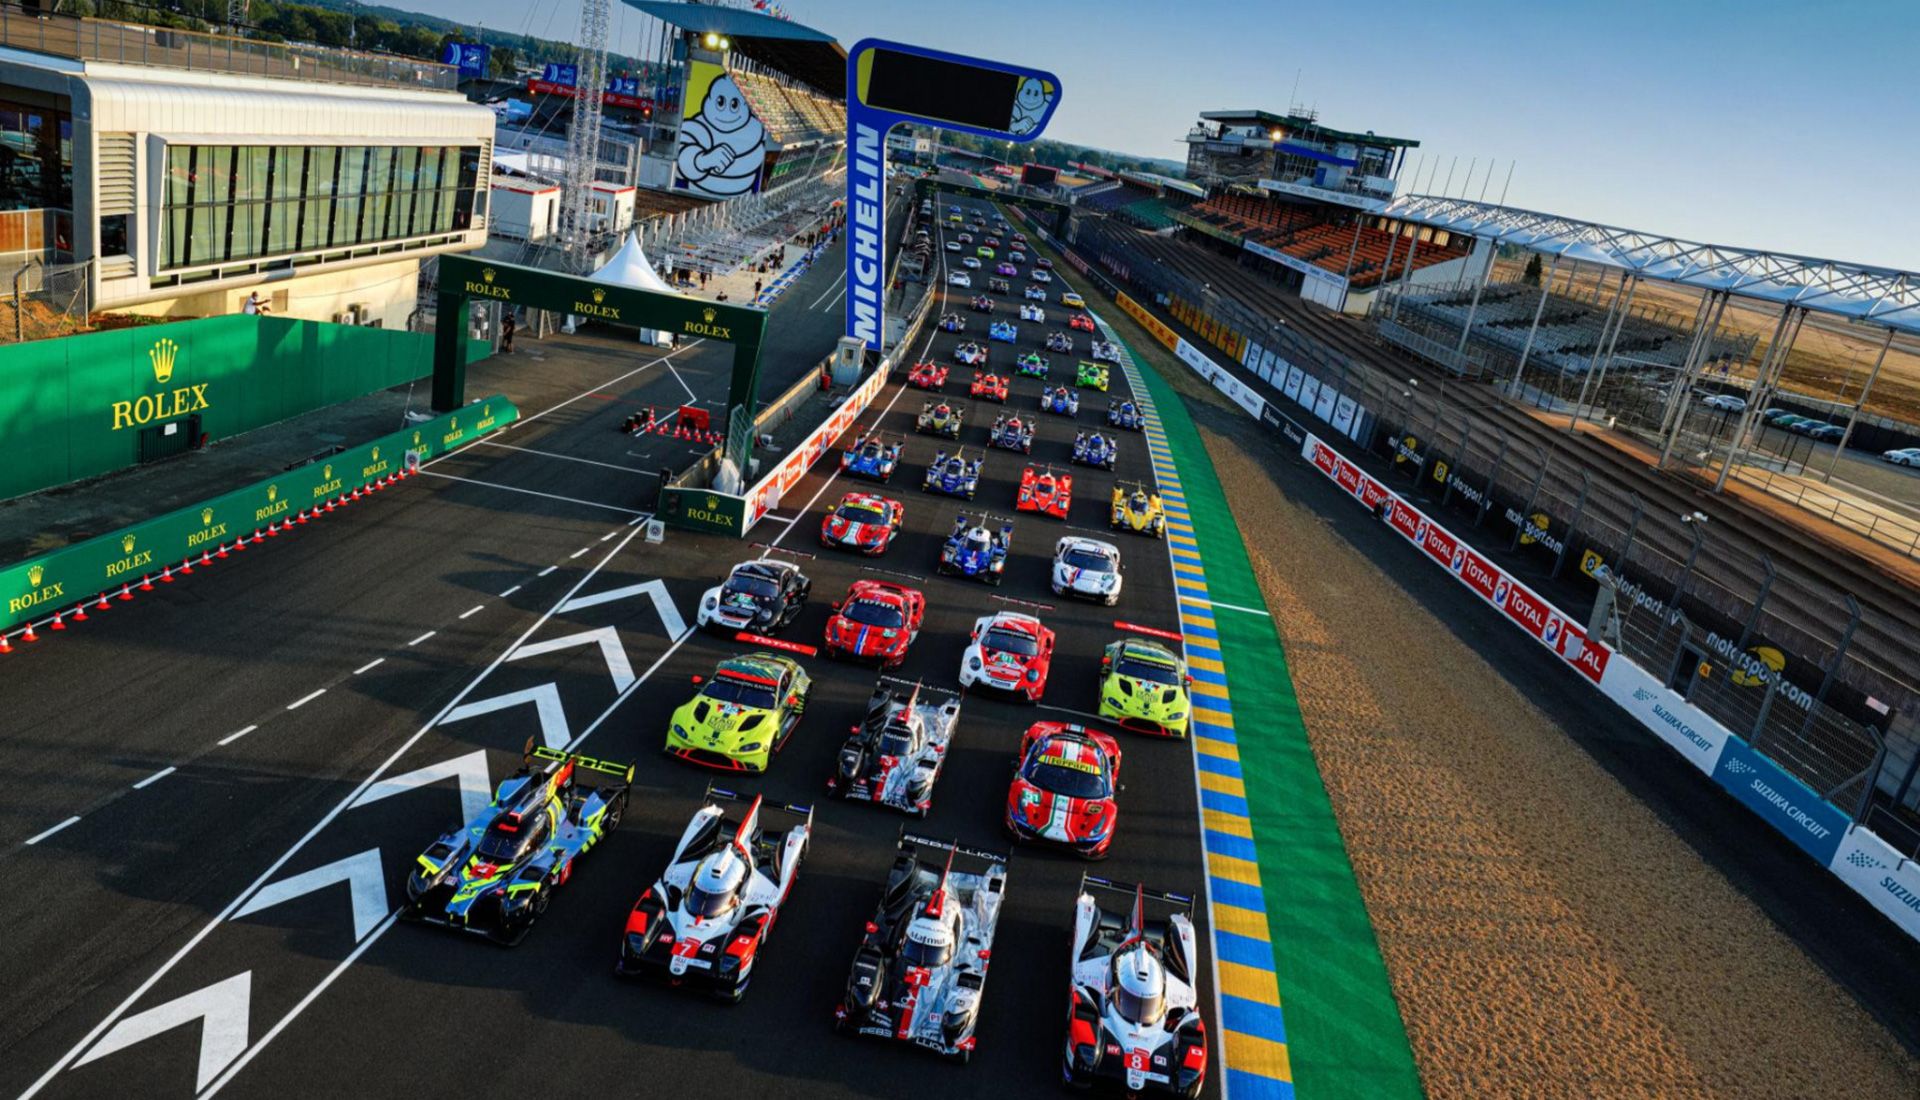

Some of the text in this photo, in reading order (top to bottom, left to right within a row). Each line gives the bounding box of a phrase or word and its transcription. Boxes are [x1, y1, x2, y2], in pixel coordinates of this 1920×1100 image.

[854, 122, 879, 344] MICHELIN
[465, 281, 511, 299] ROLEX
[574, 301, 620, 320] ROLEX
[684, 321, 731, 339] ROLEX
[111, 383, 209, 430] ROLEX
[363, 460, 388, 478] ROLEX
[1340, 463, 1358, 488] TOTAL
[313, 478, 342, 498] ROLEX
[256, 500, 288, 522] ROLEX
[687, 509, 734, 527] ROLEX
[1395, 504, 1416, 533] TOTAL
[188, 522, 227, 547] ROLEX
[1428, 529, 1452, 560] TOTAL
[106, 550, 152, 578] ROLEX
[1465, 558, 1494, 591] TOTAL
[9, 582, 64, 614] ROLEX
[1510, 590, 1543, 628] TOTAL
[752, 636, 800, 650] TOTAL
[1652, 704, 1714, 752] SUZUKA CIRCUIT
[1750, 778, 1831, 839] SUZUKA CIRCUIT
[680, 943, 692, 957] 7
[915, 973, 922, 985] 1
[1132, 1054, 1142, 1070] 8
